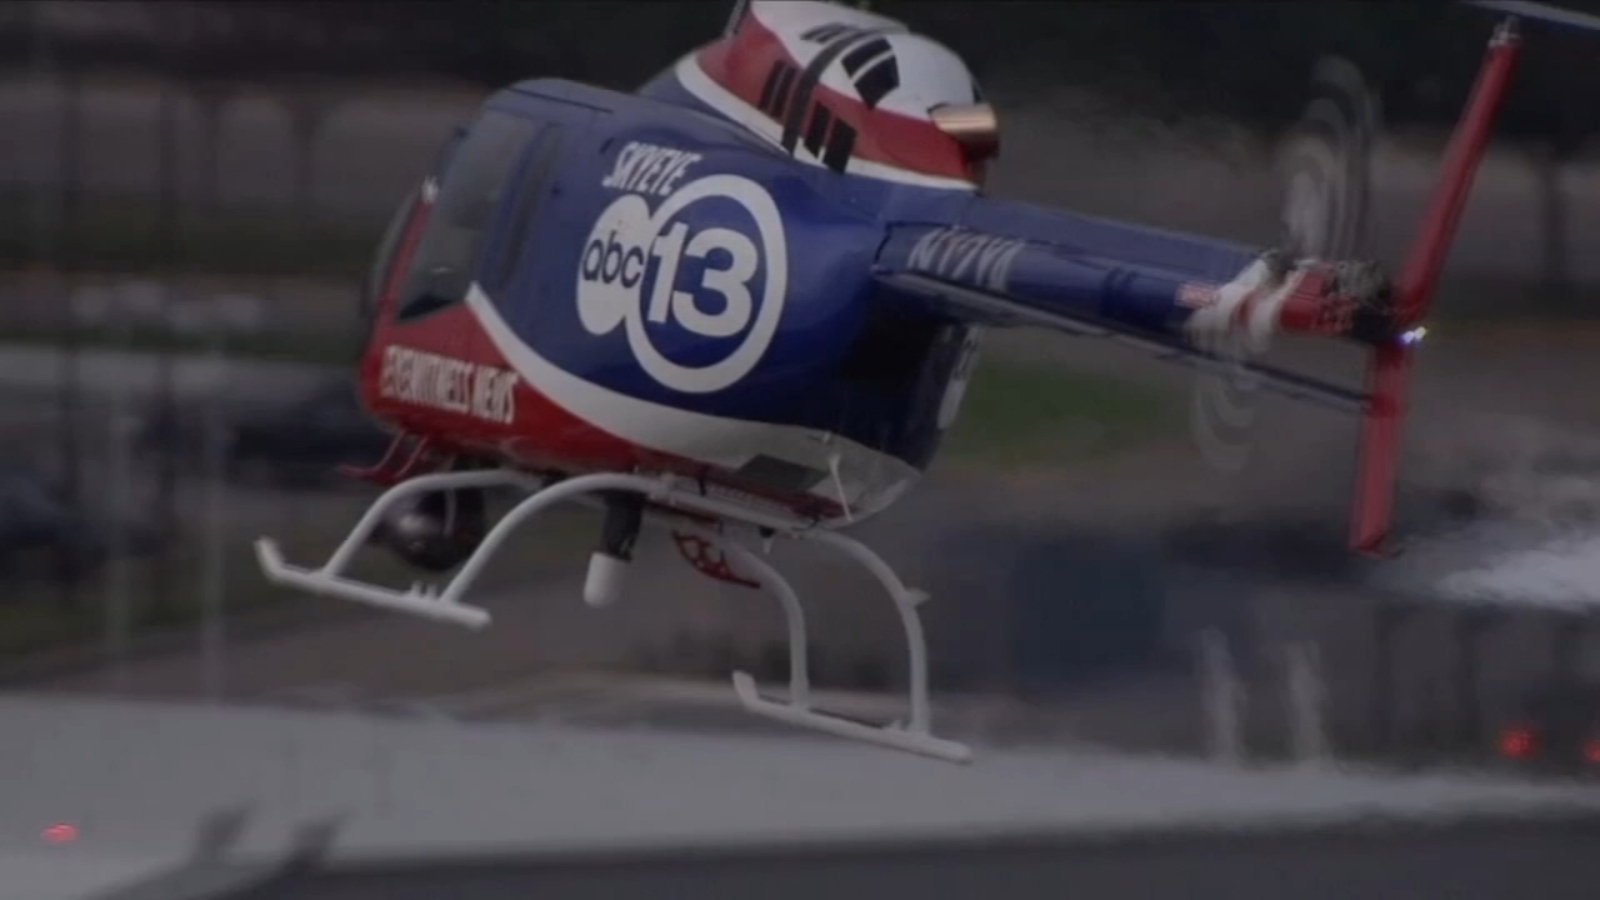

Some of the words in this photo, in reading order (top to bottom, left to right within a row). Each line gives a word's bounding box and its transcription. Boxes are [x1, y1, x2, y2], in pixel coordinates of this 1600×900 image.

[602, 141, 702, 196] SKYEYE
[582, 230, 644, 289] abc
[647, 221, 759, 337] 13
[380, 345, 474, 415] EYEWITNESS
[472, 364, 519, 425] NEWS
